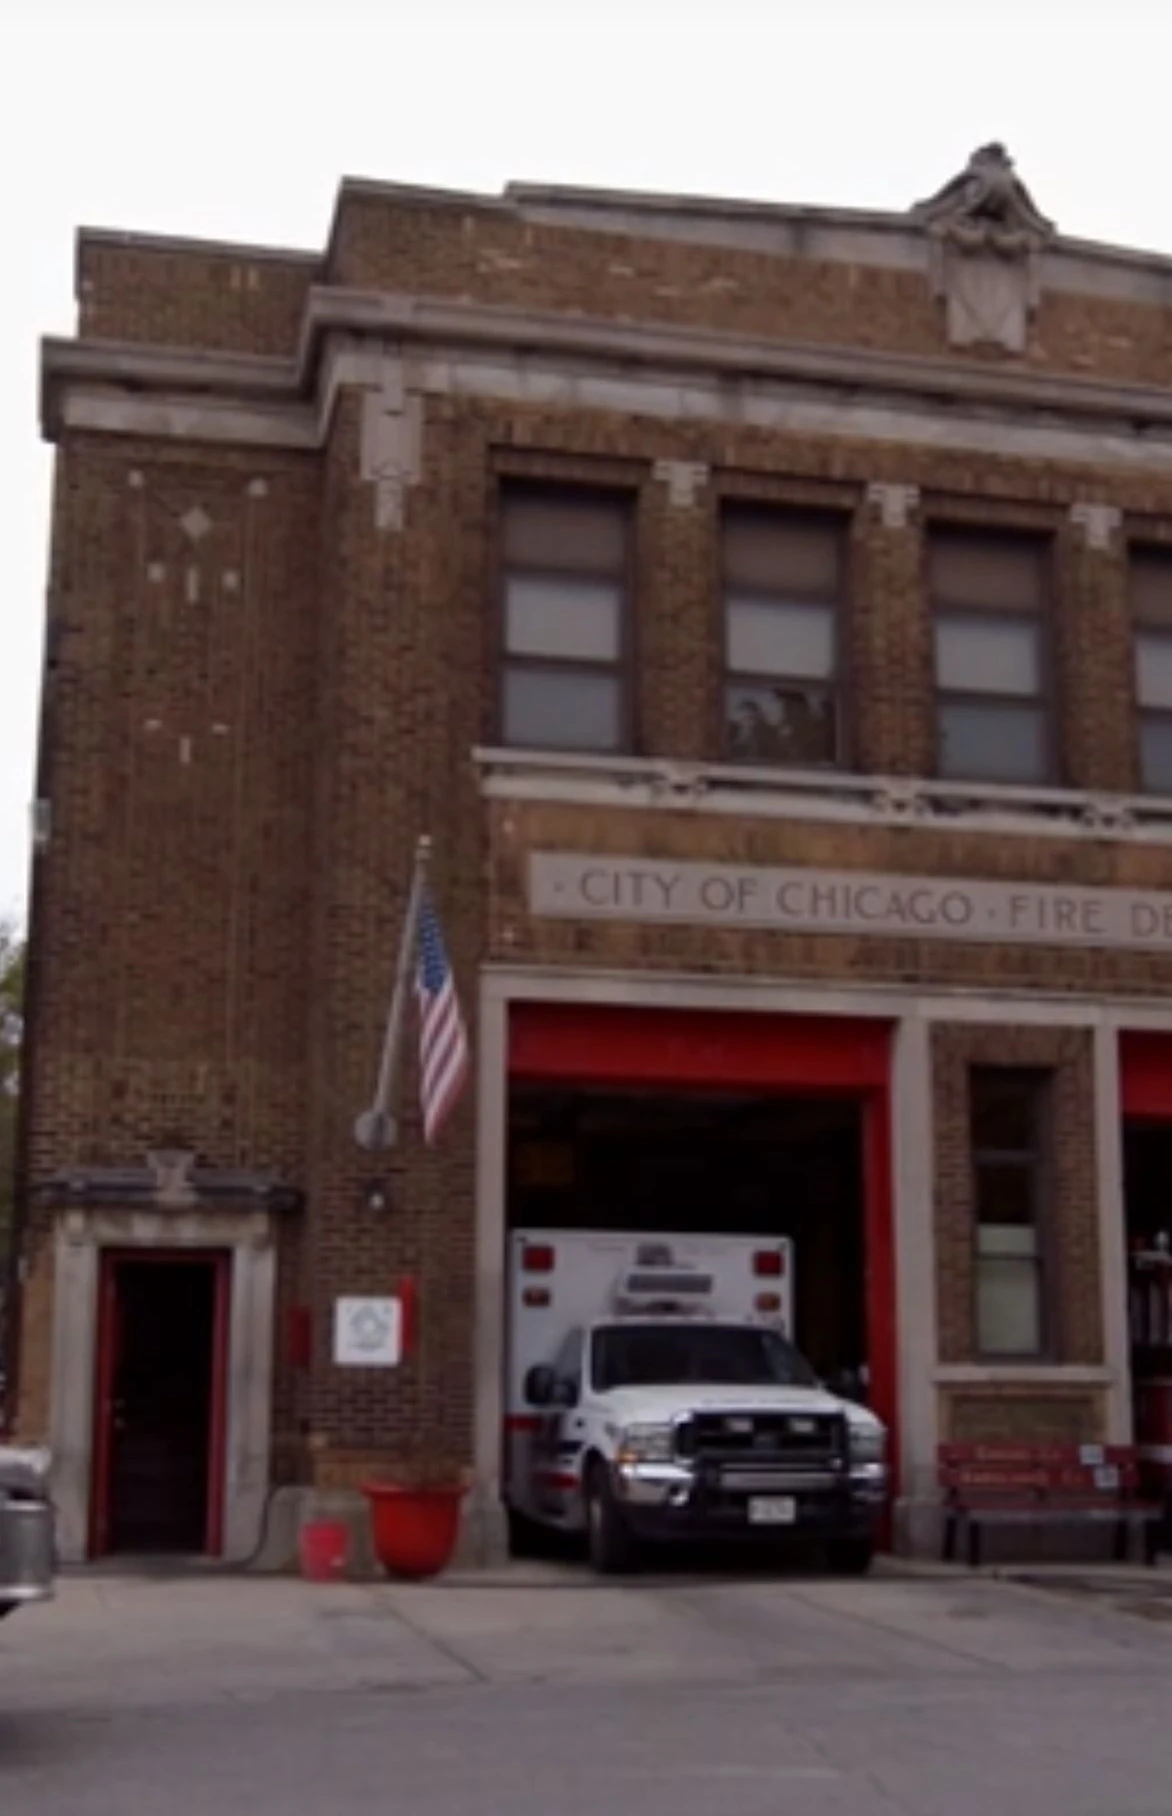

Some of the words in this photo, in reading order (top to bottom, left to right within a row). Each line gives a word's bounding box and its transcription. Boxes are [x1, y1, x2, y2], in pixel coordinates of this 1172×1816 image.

[579, 868, 681, 909] CITY
[699, 875, 758, 912] OF
[776, 880, 974, 926] CHICAGO
[1009, 894, 1105, 934] FIRE
